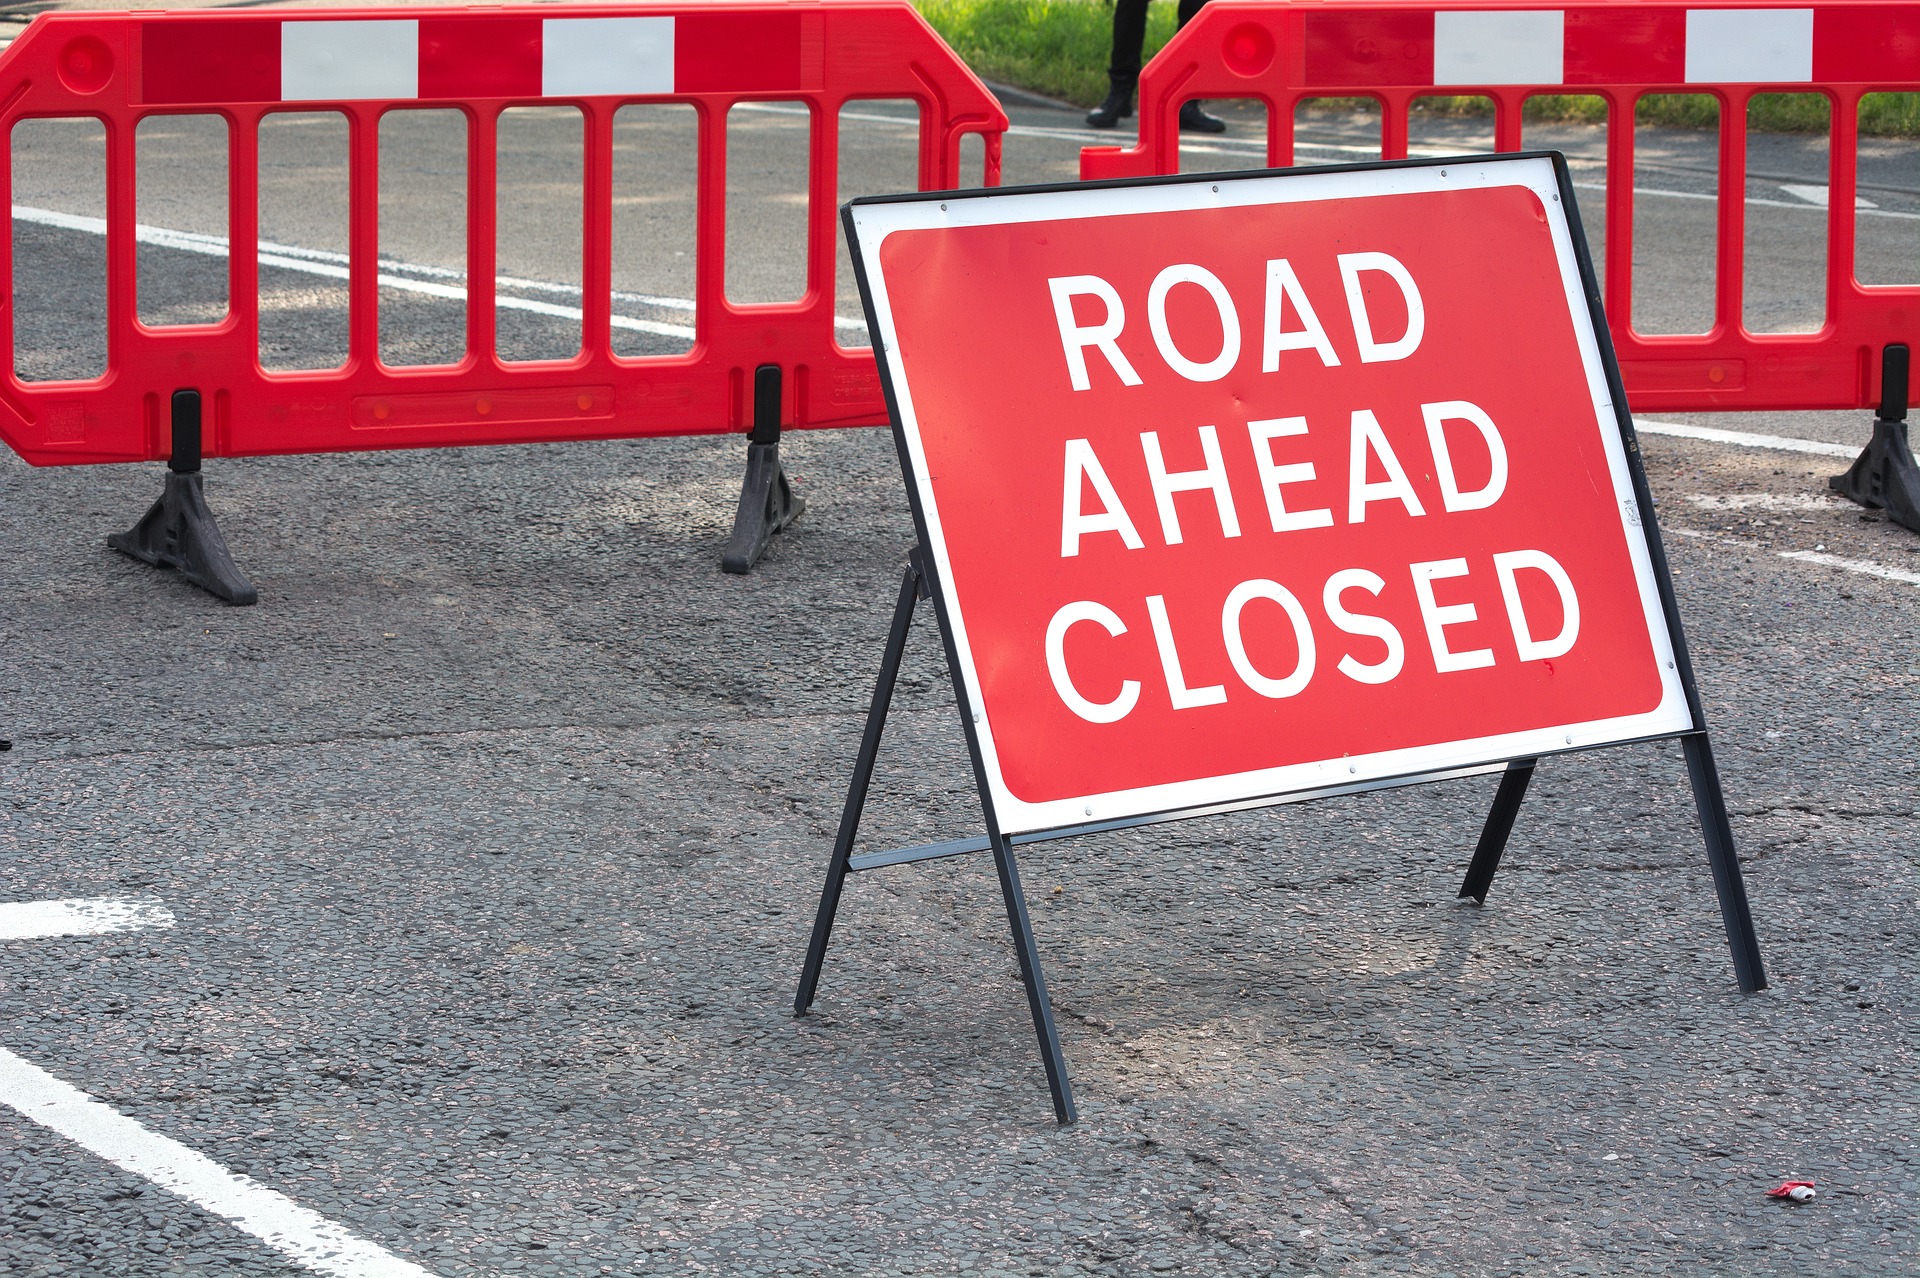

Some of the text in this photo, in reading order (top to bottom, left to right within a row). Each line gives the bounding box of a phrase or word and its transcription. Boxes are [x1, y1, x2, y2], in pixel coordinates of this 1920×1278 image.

[1048, 252, 1424, 391] ROAD
[1061, 401, 1508, 557] AHEAD
[1045, 550, 1580, 723] CLOSED
